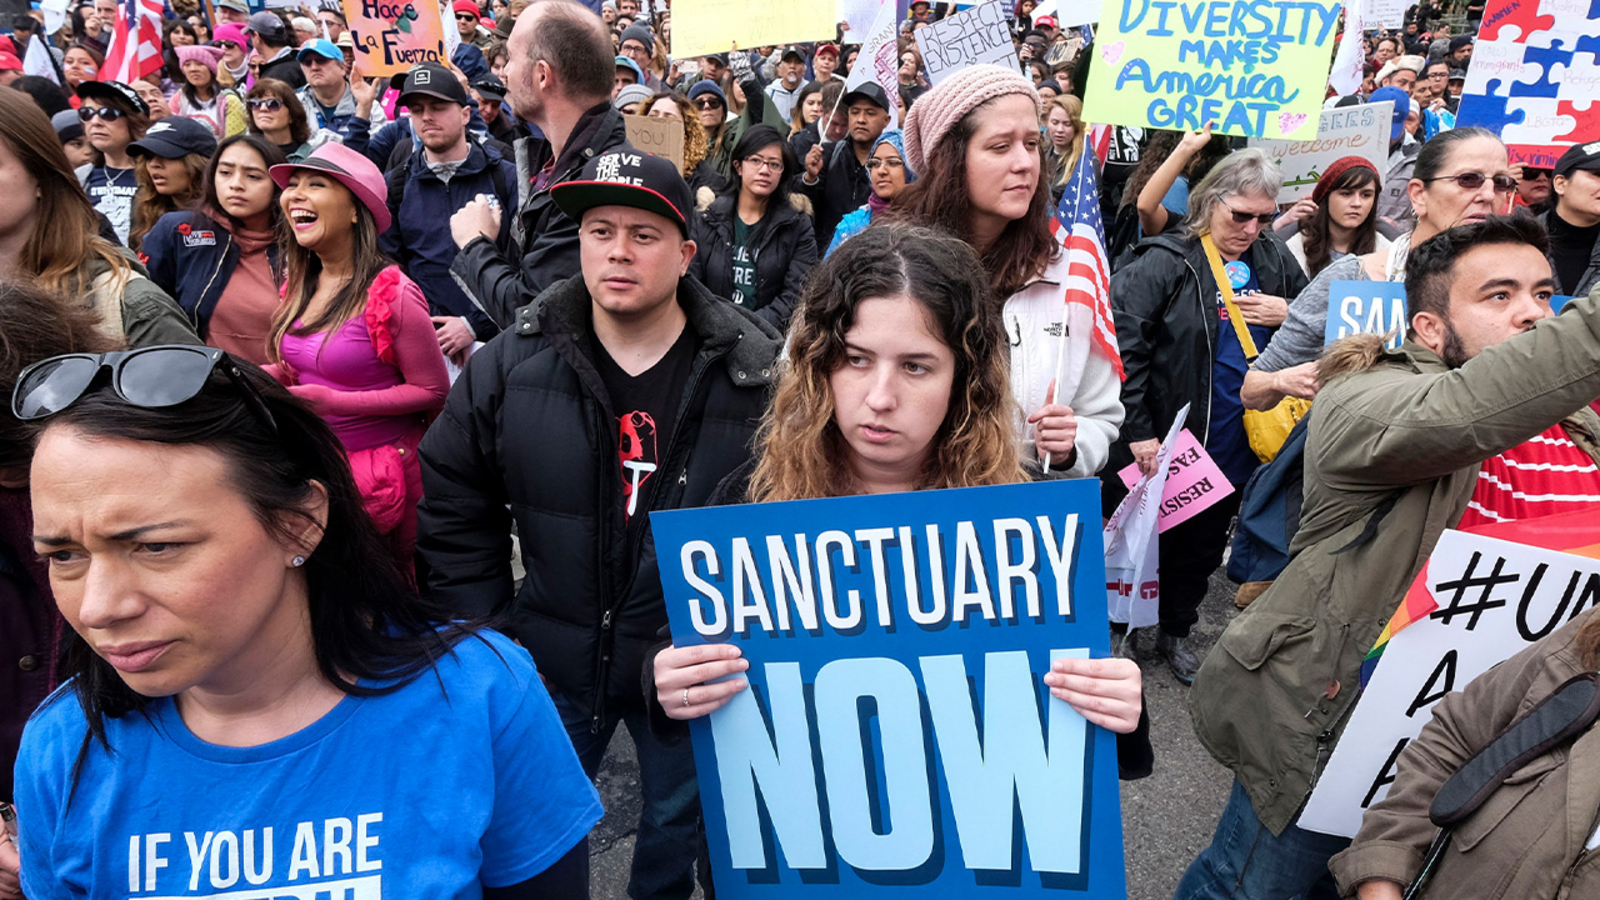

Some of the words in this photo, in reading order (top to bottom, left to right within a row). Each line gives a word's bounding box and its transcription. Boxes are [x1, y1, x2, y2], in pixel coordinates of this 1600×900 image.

[363, 0, 418, 21] Hace
[921, 0, 1001, 50] RESPECT
[1119, 0, 1341, 47] DIVERSITY
[1483, 0, 1521, 28] WOMEN
[351, 30, 379, 54] La
[382, 29, 444, 65] Fuerza!
[924, 20, 1012, 74] EXISTENCE
[1179, 39, 1281, 73] MAKES
[1474, 57, 1526, 74] Immigrants
[1115, 58, 1299, 104] America
[631, 128, 665, 145] YOU
[1147, 95, 1280, 138] GREAT
[1318, 107, 1376, 132] GEES
[595, 164, 621, 180] THE
[598, 153, 642, 167] SERVE
[1338, 296, 1410, 350] SAN
[1159, 476, 1215, 519] RESIST
[680, 513, 1081, 638] SANCTUARY
[703, 648, 1091, 876] NOW
[128, 833, 172, 893] IF
[183, 826, 274, 891] YOU
[288, 812, 384, 881] ARE
